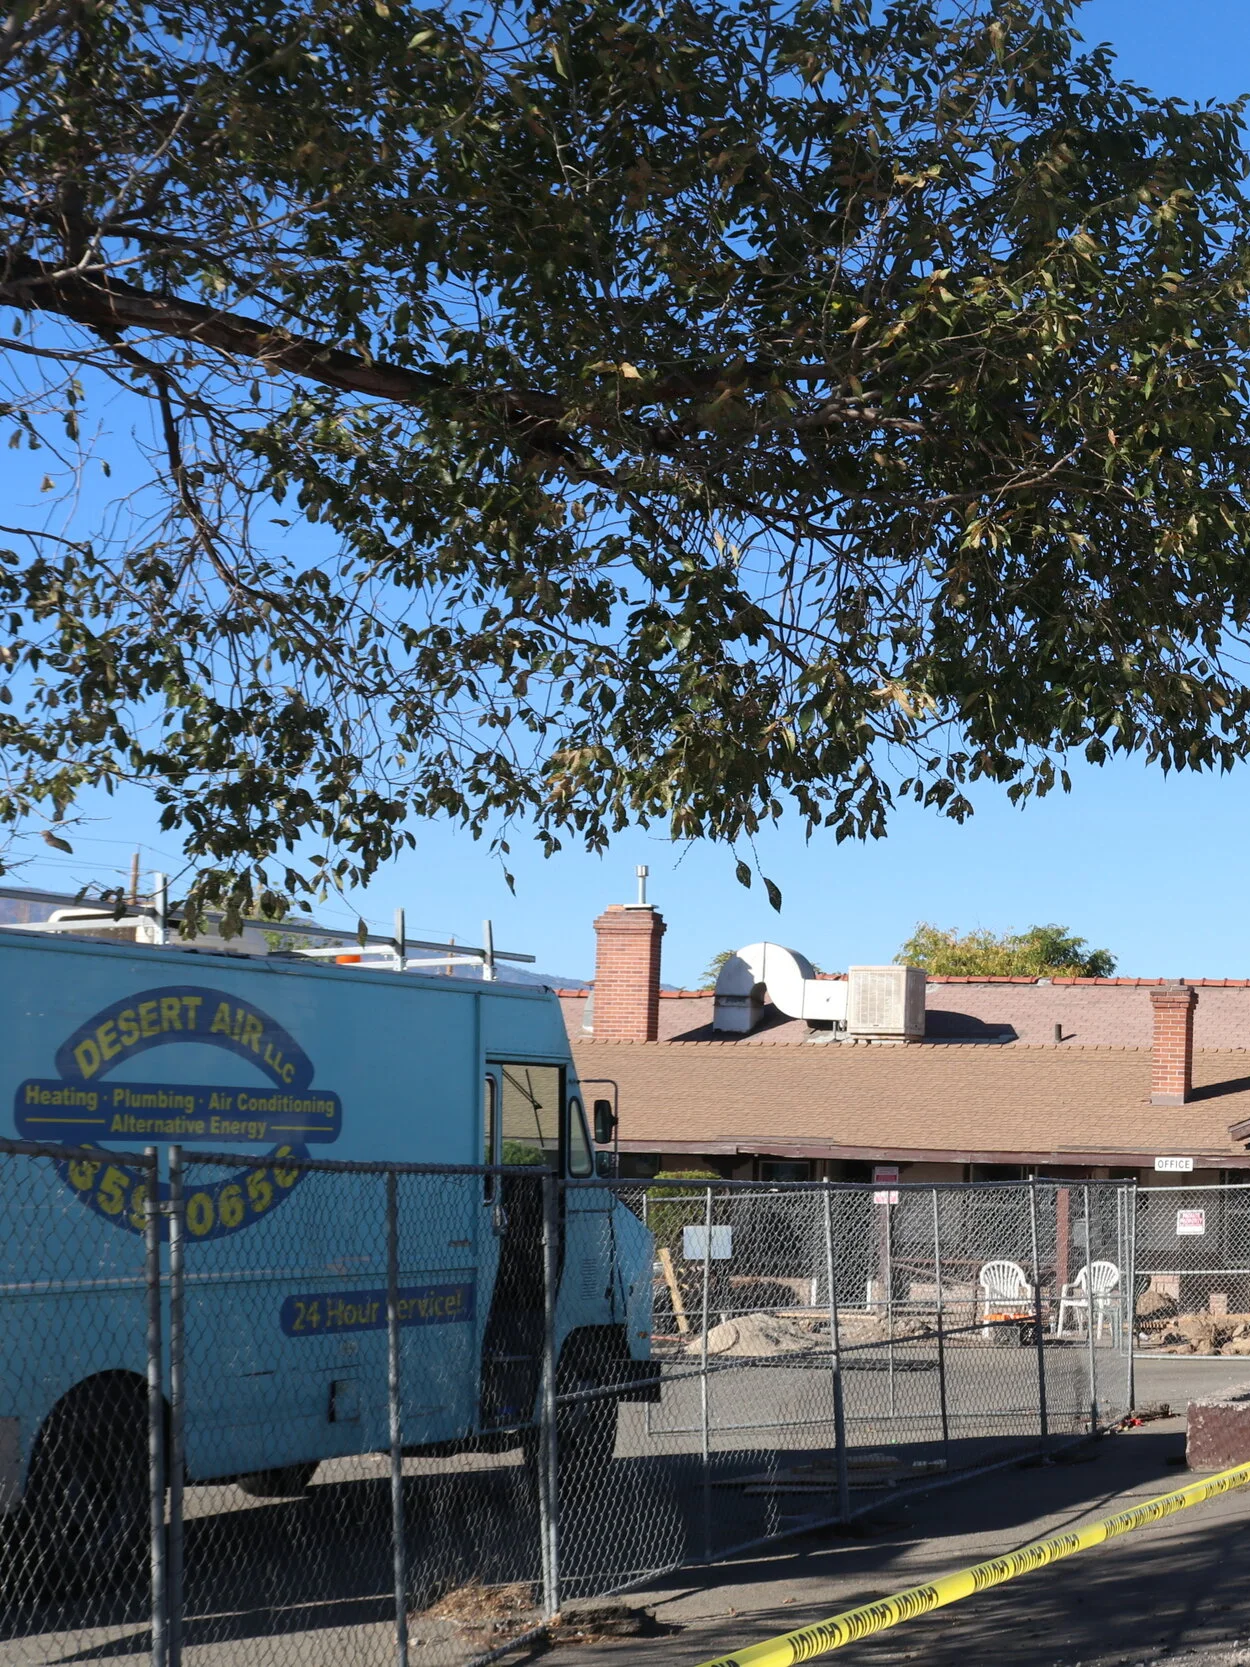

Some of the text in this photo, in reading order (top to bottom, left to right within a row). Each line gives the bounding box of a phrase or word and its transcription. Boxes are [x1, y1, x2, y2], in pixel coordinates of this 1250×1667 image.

[73, 996, 295, 1084] DESERT AIR LLC
[25, 1085, 335, 1118] Heating Plumbing Air Conditioning
[110, 1114, 267, 1139] Alternative Energy
[1157, 1159, 1191, 1169] OFFICE
[292, 1287, 465, 1331] 24 Hour ervice!
